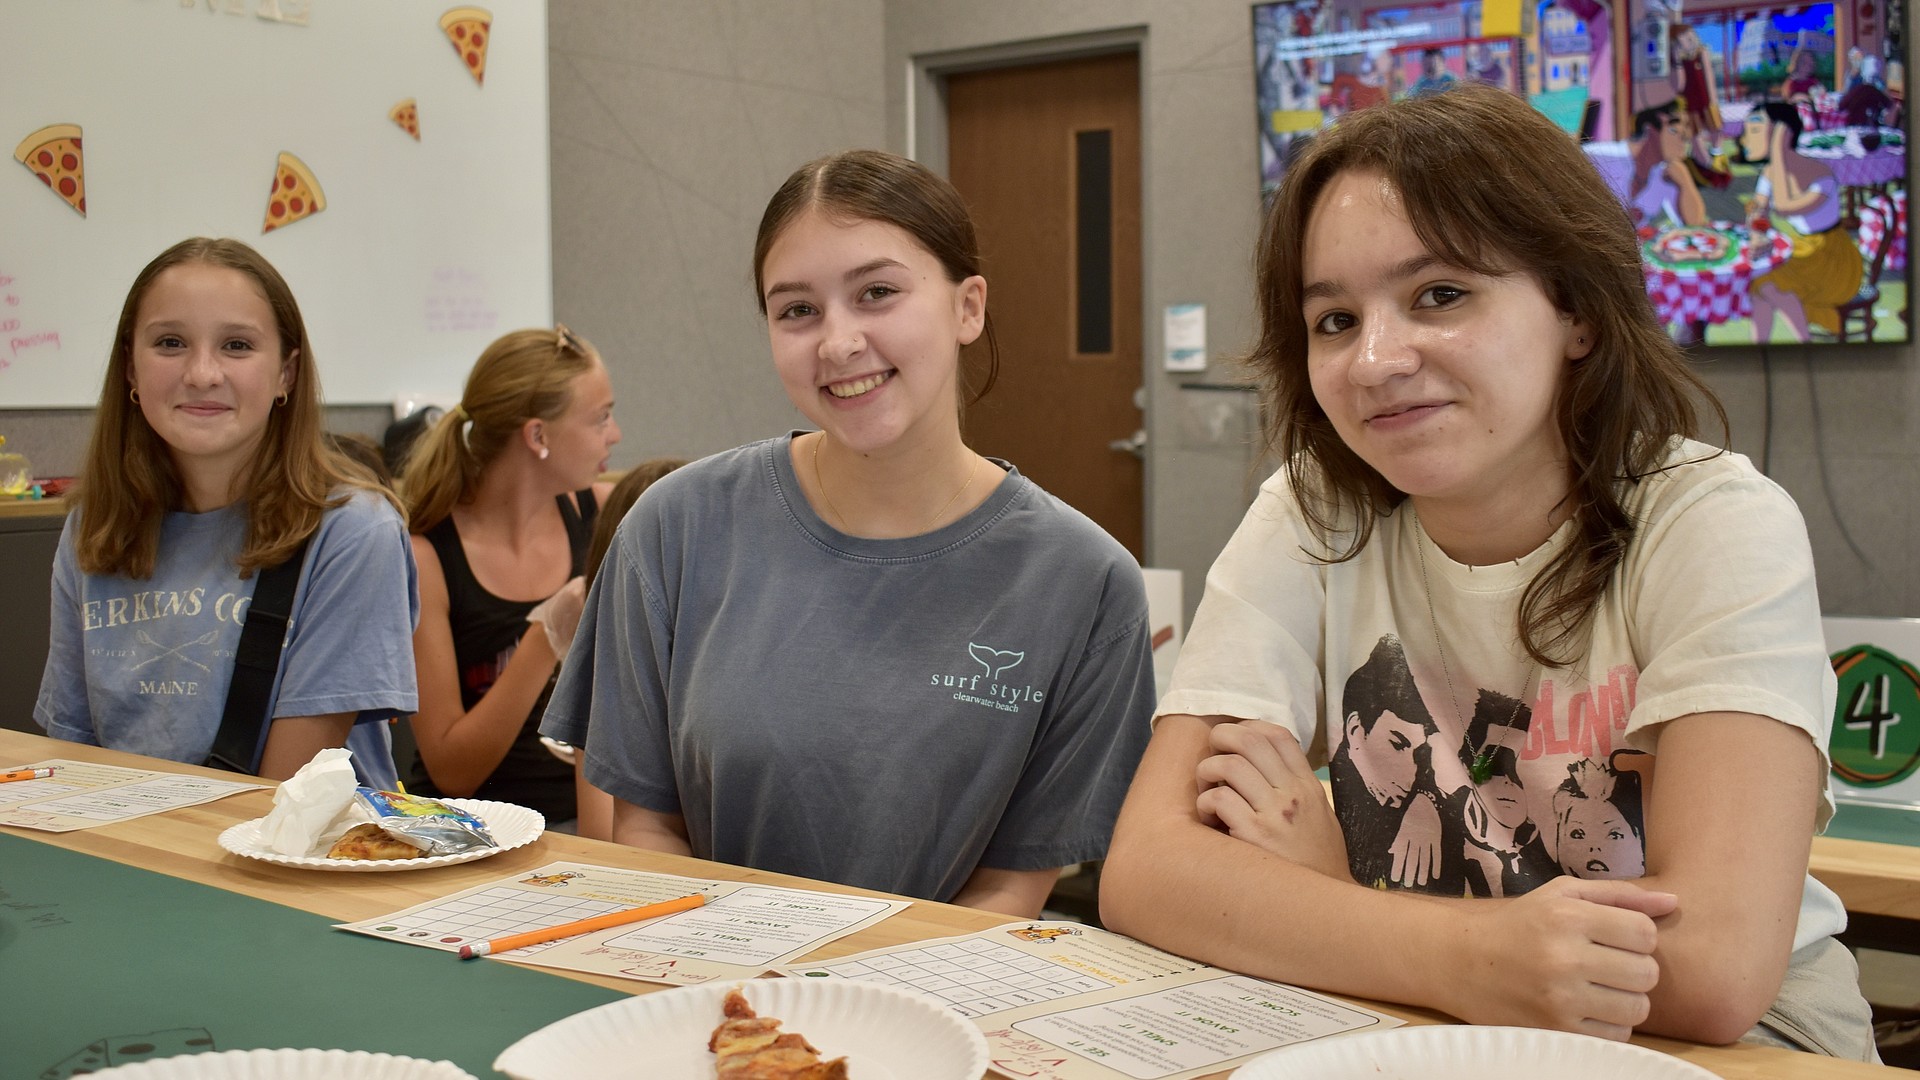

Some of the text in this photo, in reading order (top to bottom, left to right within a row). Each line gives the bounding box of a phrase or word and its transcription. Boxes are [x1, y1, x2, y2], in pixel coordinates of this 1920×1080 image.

[82, 588, 205, 631] ERKINS
[139, 681, 198, 695] MAINE
[930, 673, 1044, 704] surf style
[953, 691, 1019, 713] clearwater beach
[1520, 664, 1640, 760] BLOND
[1844, 674, 1900, 760] 4
[782, 902, 825, 912] SCORE
[745, 919, 792, 929] SAVOR
[713, 933, 753, 943] SMELL
[1048, 953, 1088, 969] SCALE
[1087, 966, 1129, 985] RATING
[1255, 1001, 1301, 1017] SCORE
[1192, 1016, 1239, 1034] SAVOR
[1137, 1029, 1178, 1046] SMELL
[1083, 1047, 1111, 1058] SEE
